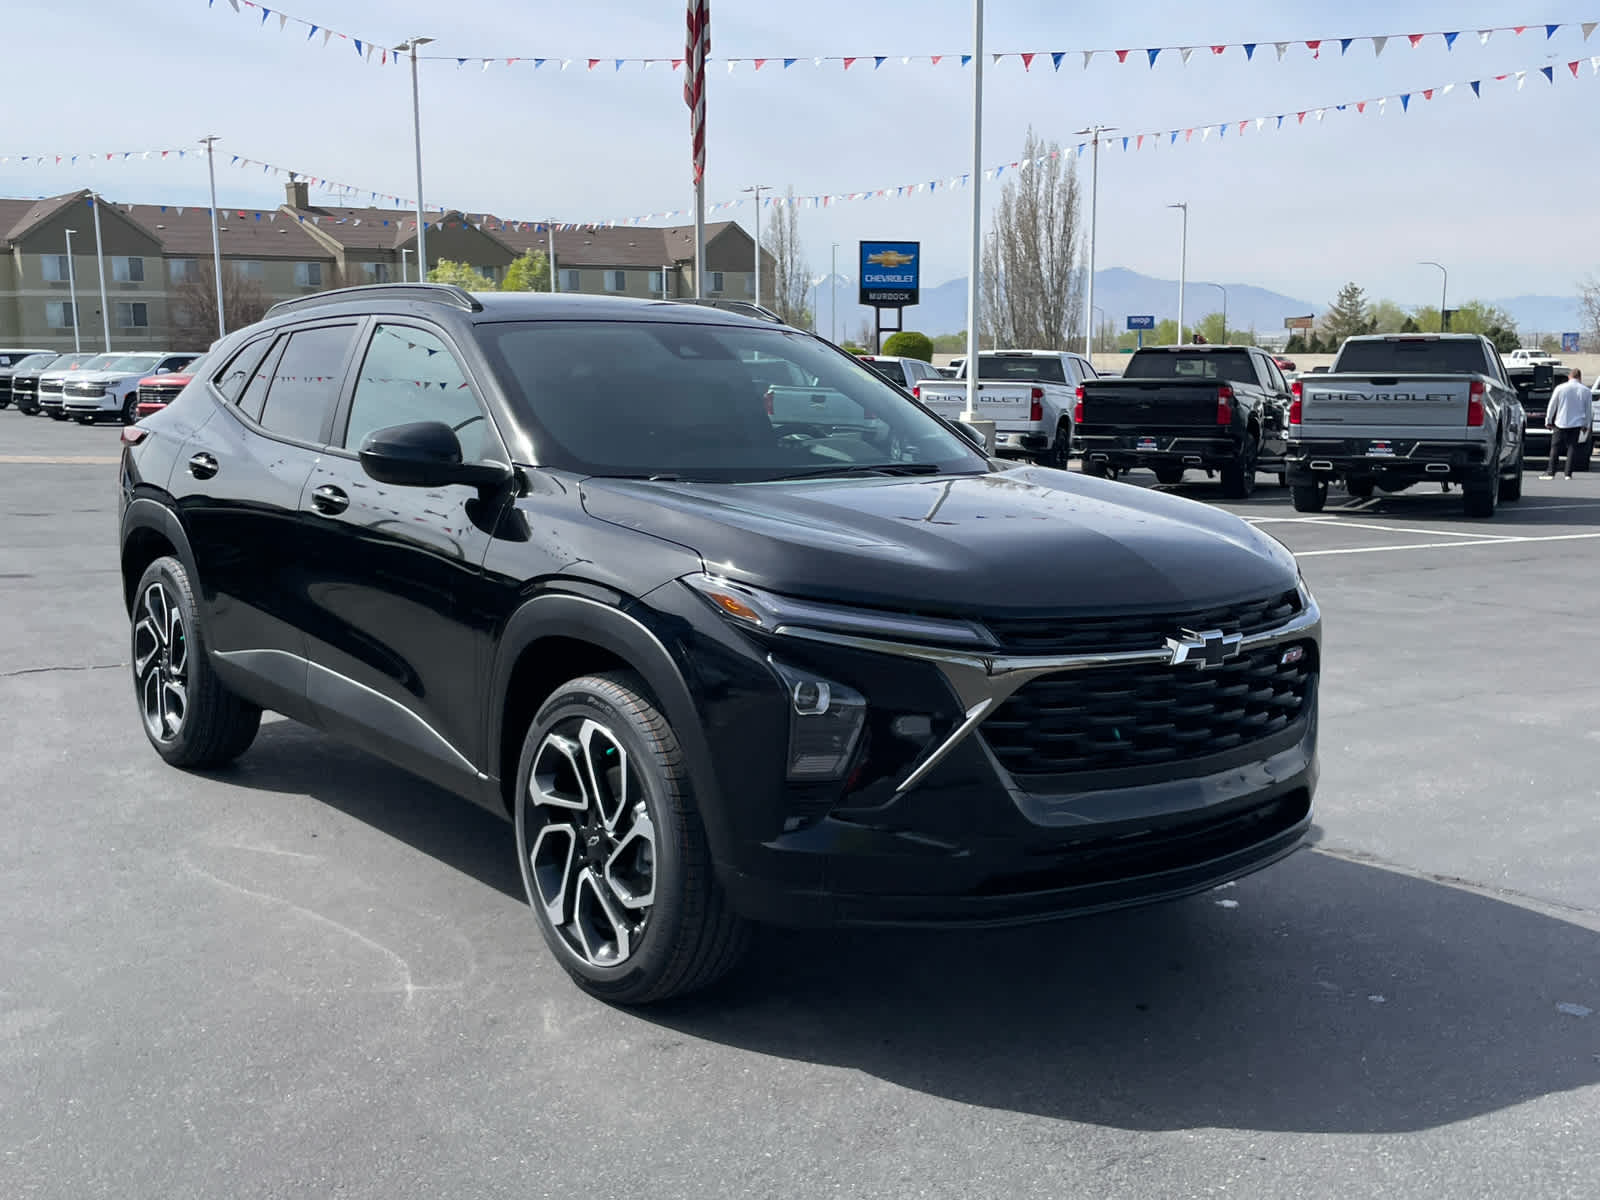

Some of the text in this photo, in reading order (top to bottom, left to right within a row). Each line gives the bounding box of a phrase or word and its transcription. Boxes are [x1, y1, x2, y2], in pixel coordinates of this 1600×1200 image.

[865, 274, 914, 283] CHEVROLET
[926, 394, 1023, 404] CHEVOLET
[1312, 392, 1457, 402] CHEVROLET
